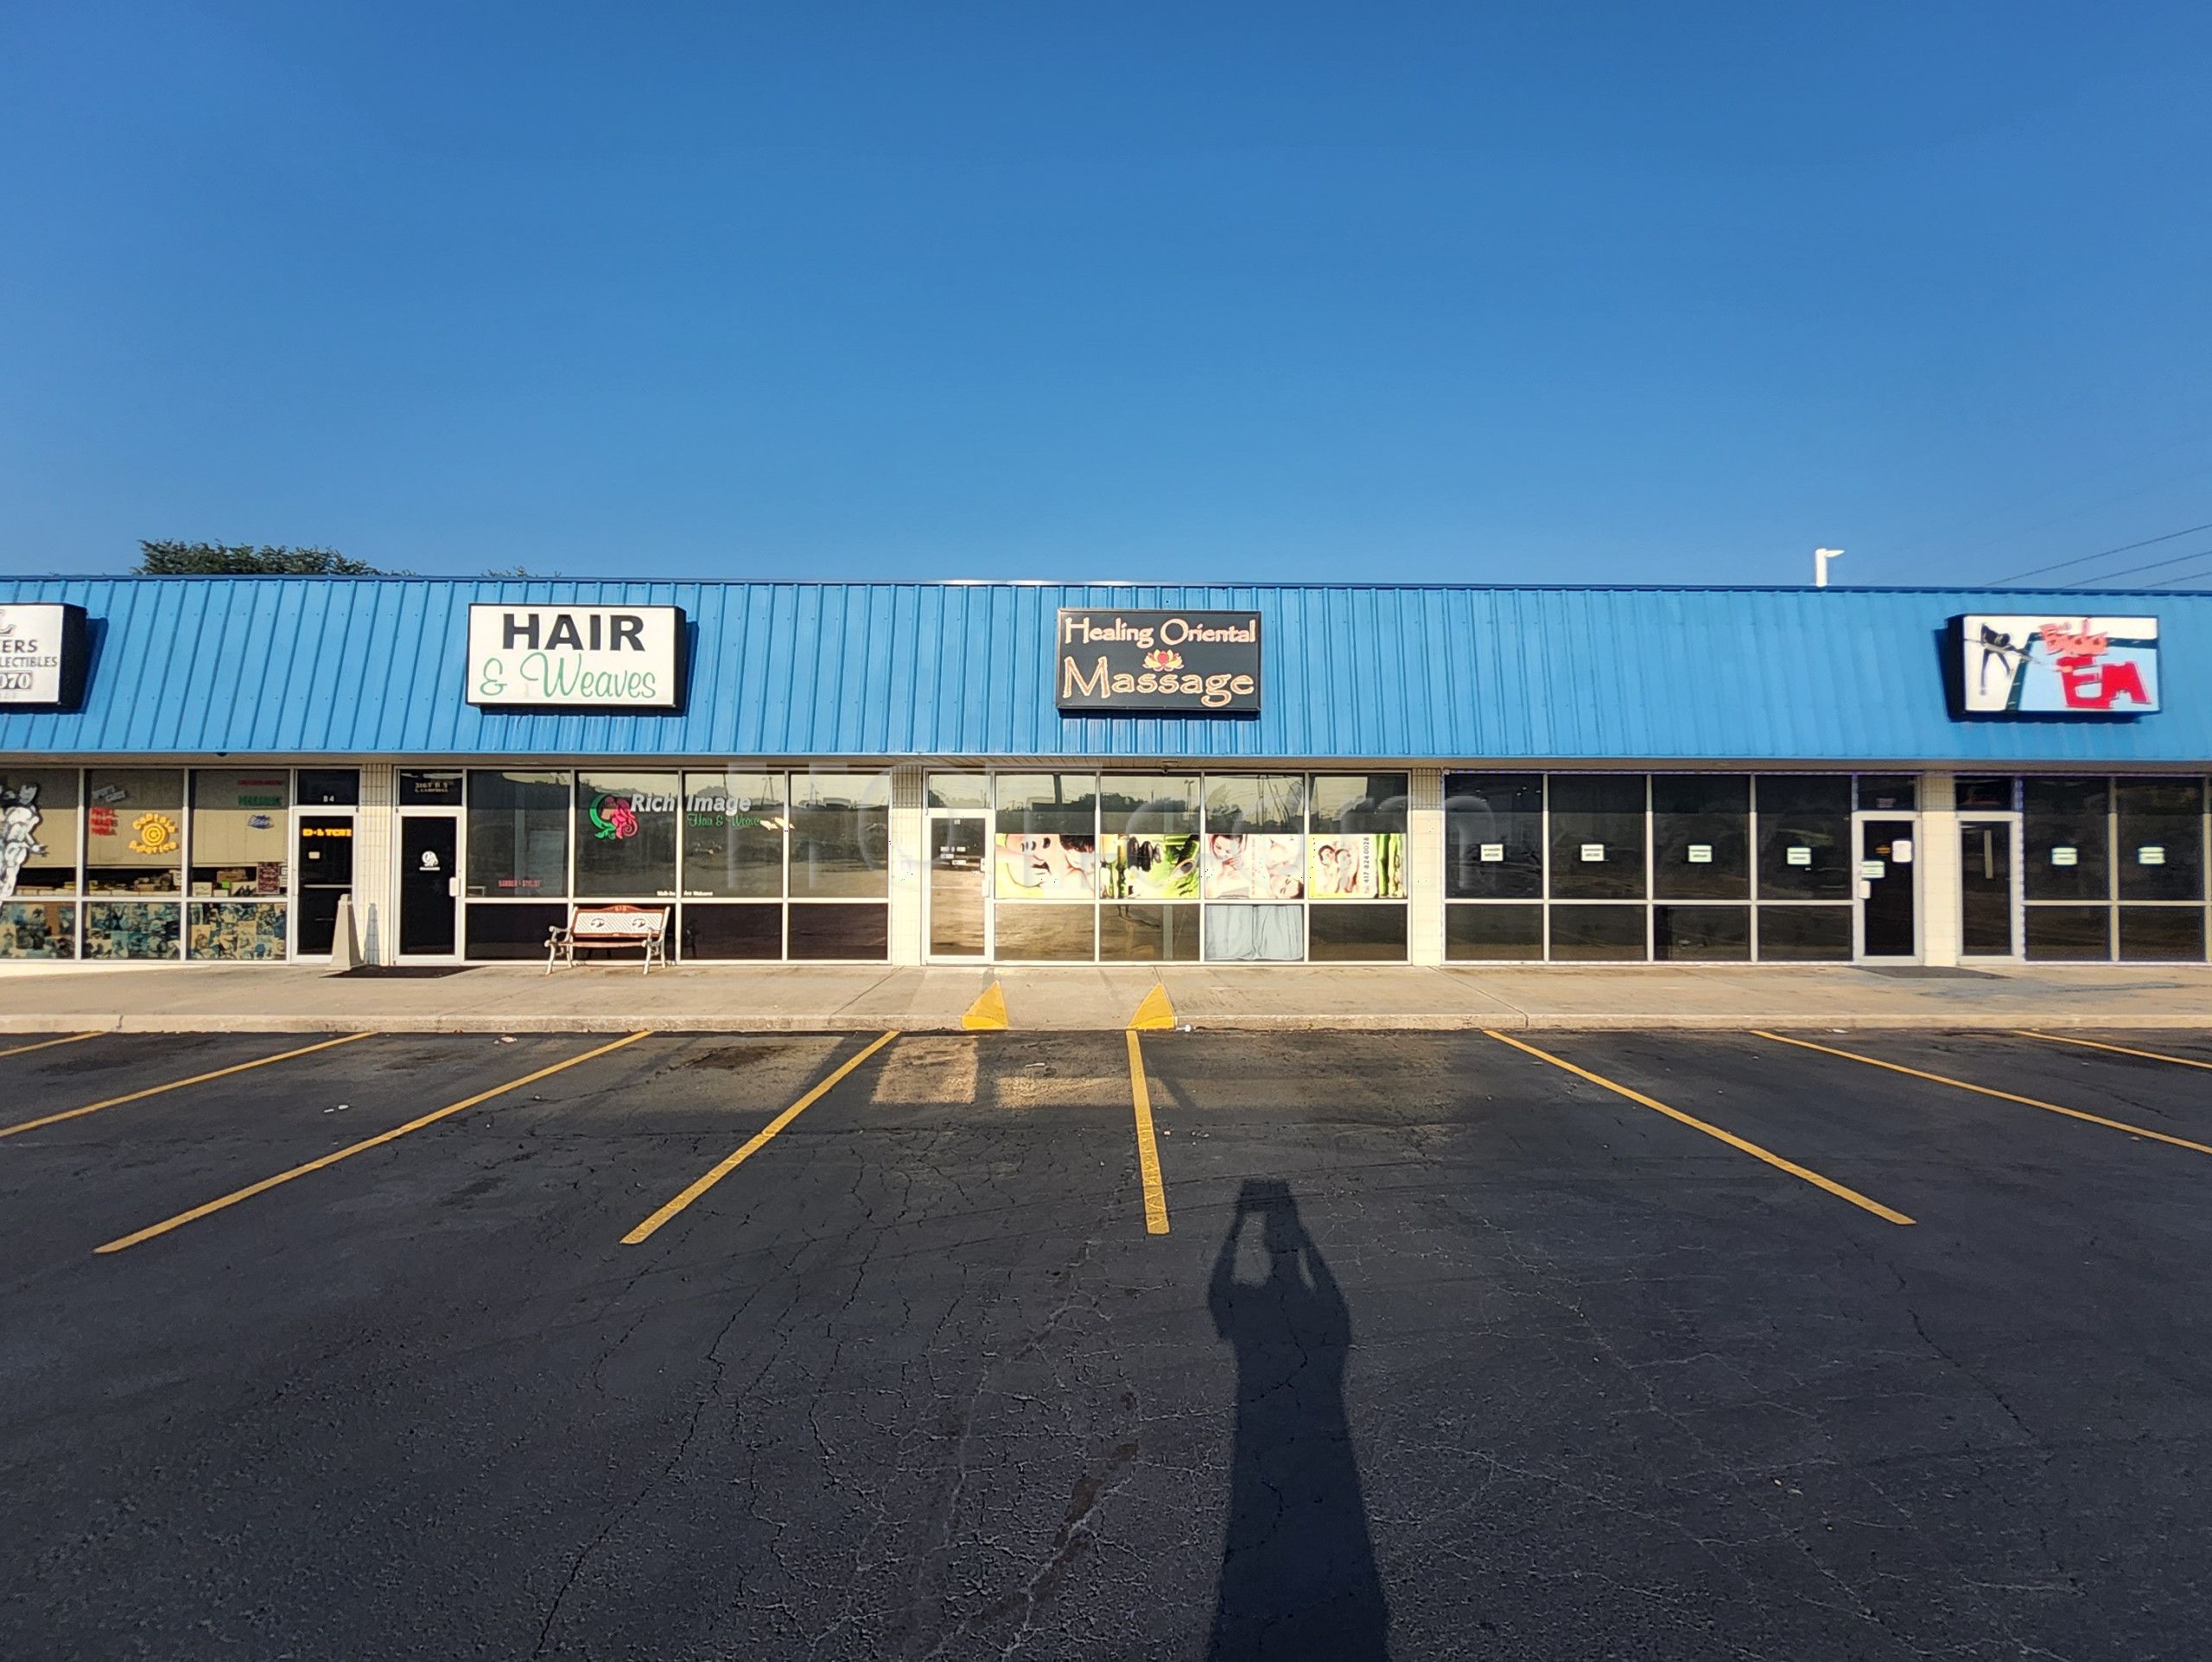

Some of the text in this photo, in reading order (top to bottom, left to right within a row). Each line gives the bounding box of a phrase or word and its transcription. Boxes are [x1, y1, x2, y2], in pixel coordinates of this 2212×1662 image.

[502, 613, 645, 652] HAIR
[1065, 616, 1257, 649] Healing Oriental
[480, 652, 657, 698] & Weaves
[1062, 655, 1255, 709] Massage
[630, 794, 752, 816] Rich Image
[715, 814, 724, 826] &
